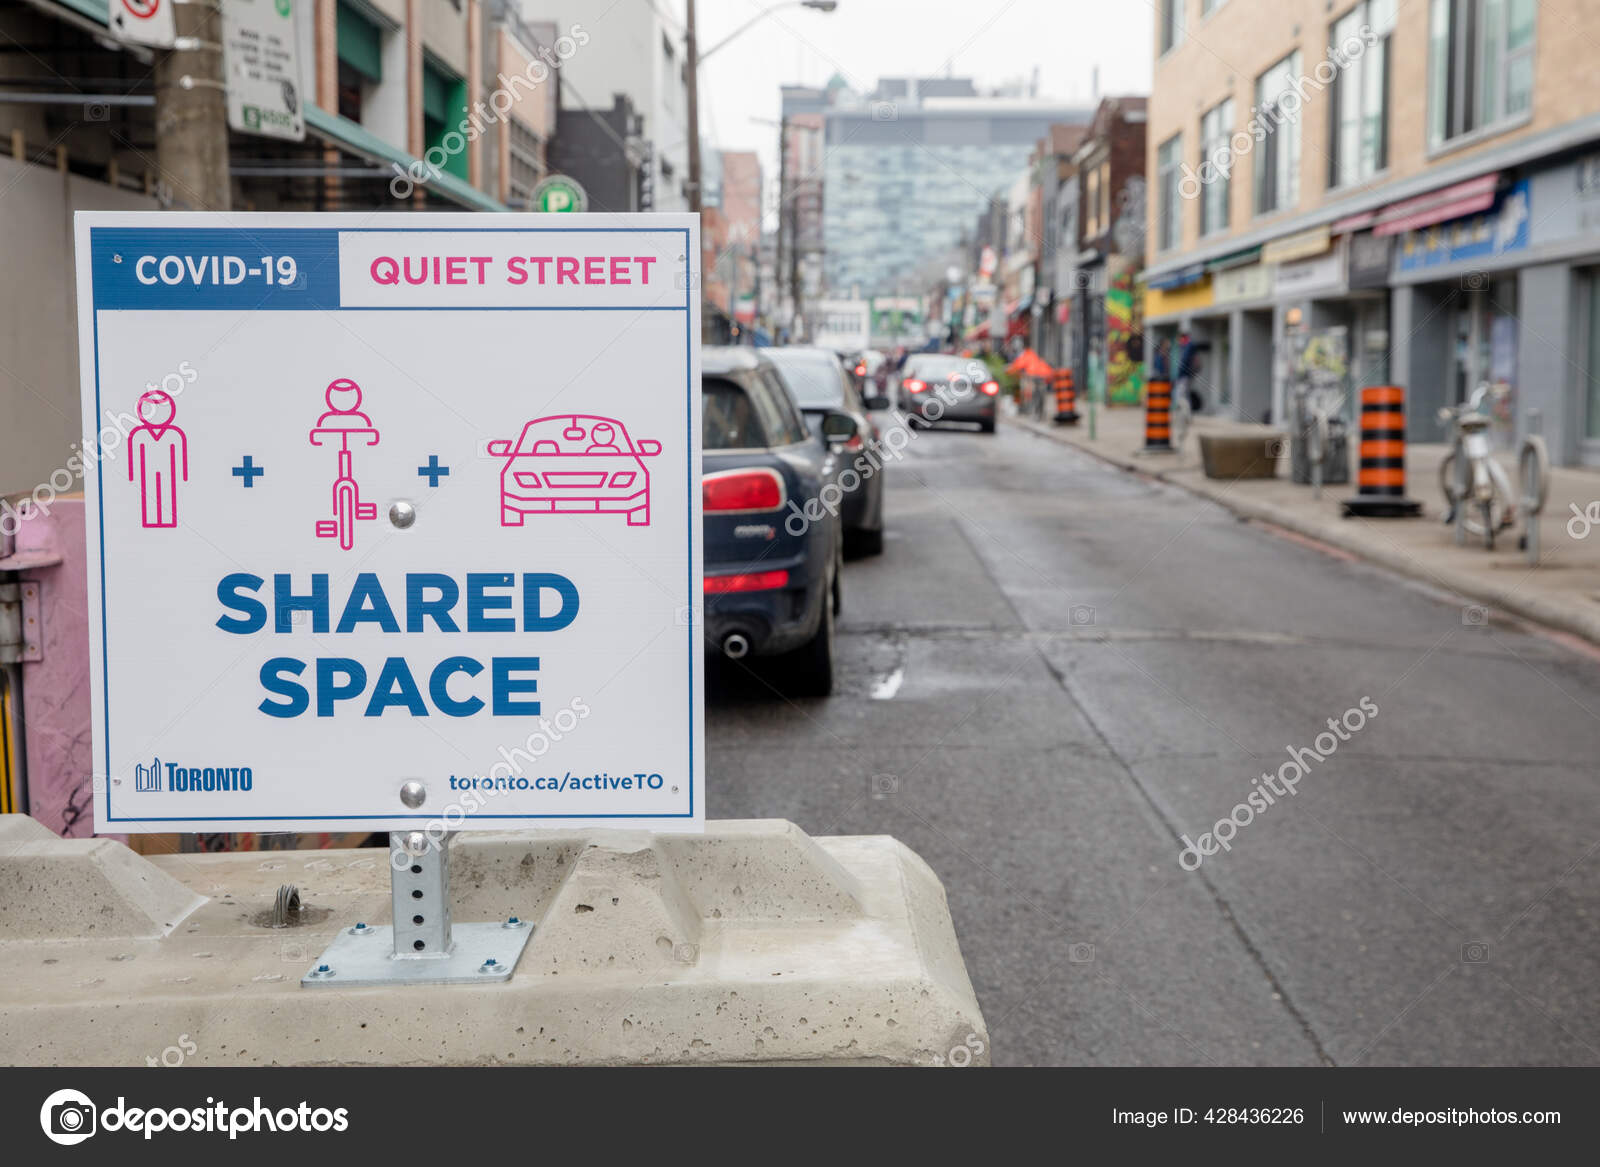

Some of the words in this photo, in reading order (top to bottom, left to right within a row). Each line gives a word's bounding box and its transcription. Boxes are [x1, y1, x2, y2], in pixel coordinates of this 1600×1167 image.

[136, 255, 298, 286] COVID-19
[370, 256, 493, 285] QUIET
[508, 257, 656, 284] STREET
[216, 573, 579, 634] SHARED
[259, 656, 540, 718] SPACE
[165, 762, 253, 792] TORONTO
[449, 772, 664, 792] toronto.ca/activeTO
